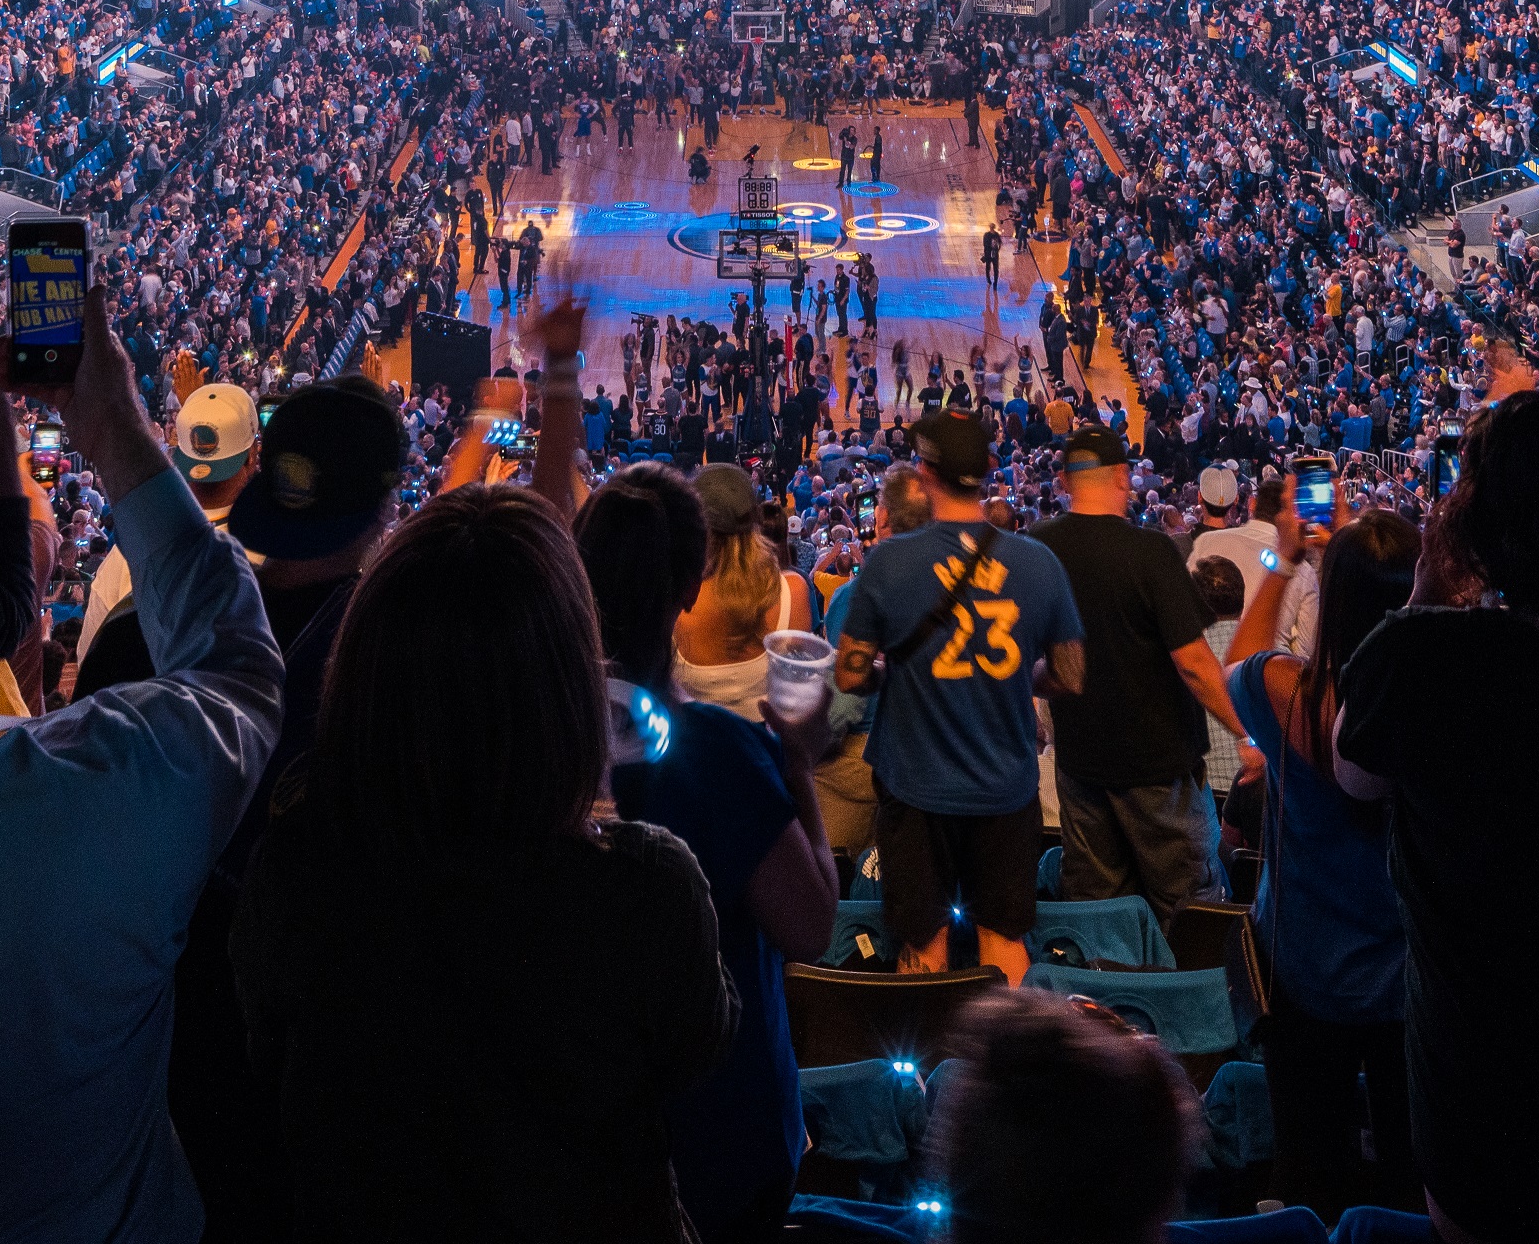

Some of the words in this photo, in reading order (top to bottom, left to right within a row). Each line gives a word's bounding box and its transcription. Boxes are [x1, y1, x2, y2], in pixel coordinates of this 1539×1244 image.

[13, 248, 42, 256] CHASE
[54, 248, 82, 256] CENTER
[654, 424, 666, 436] 30
[931, 599, 1023, 681] 23
